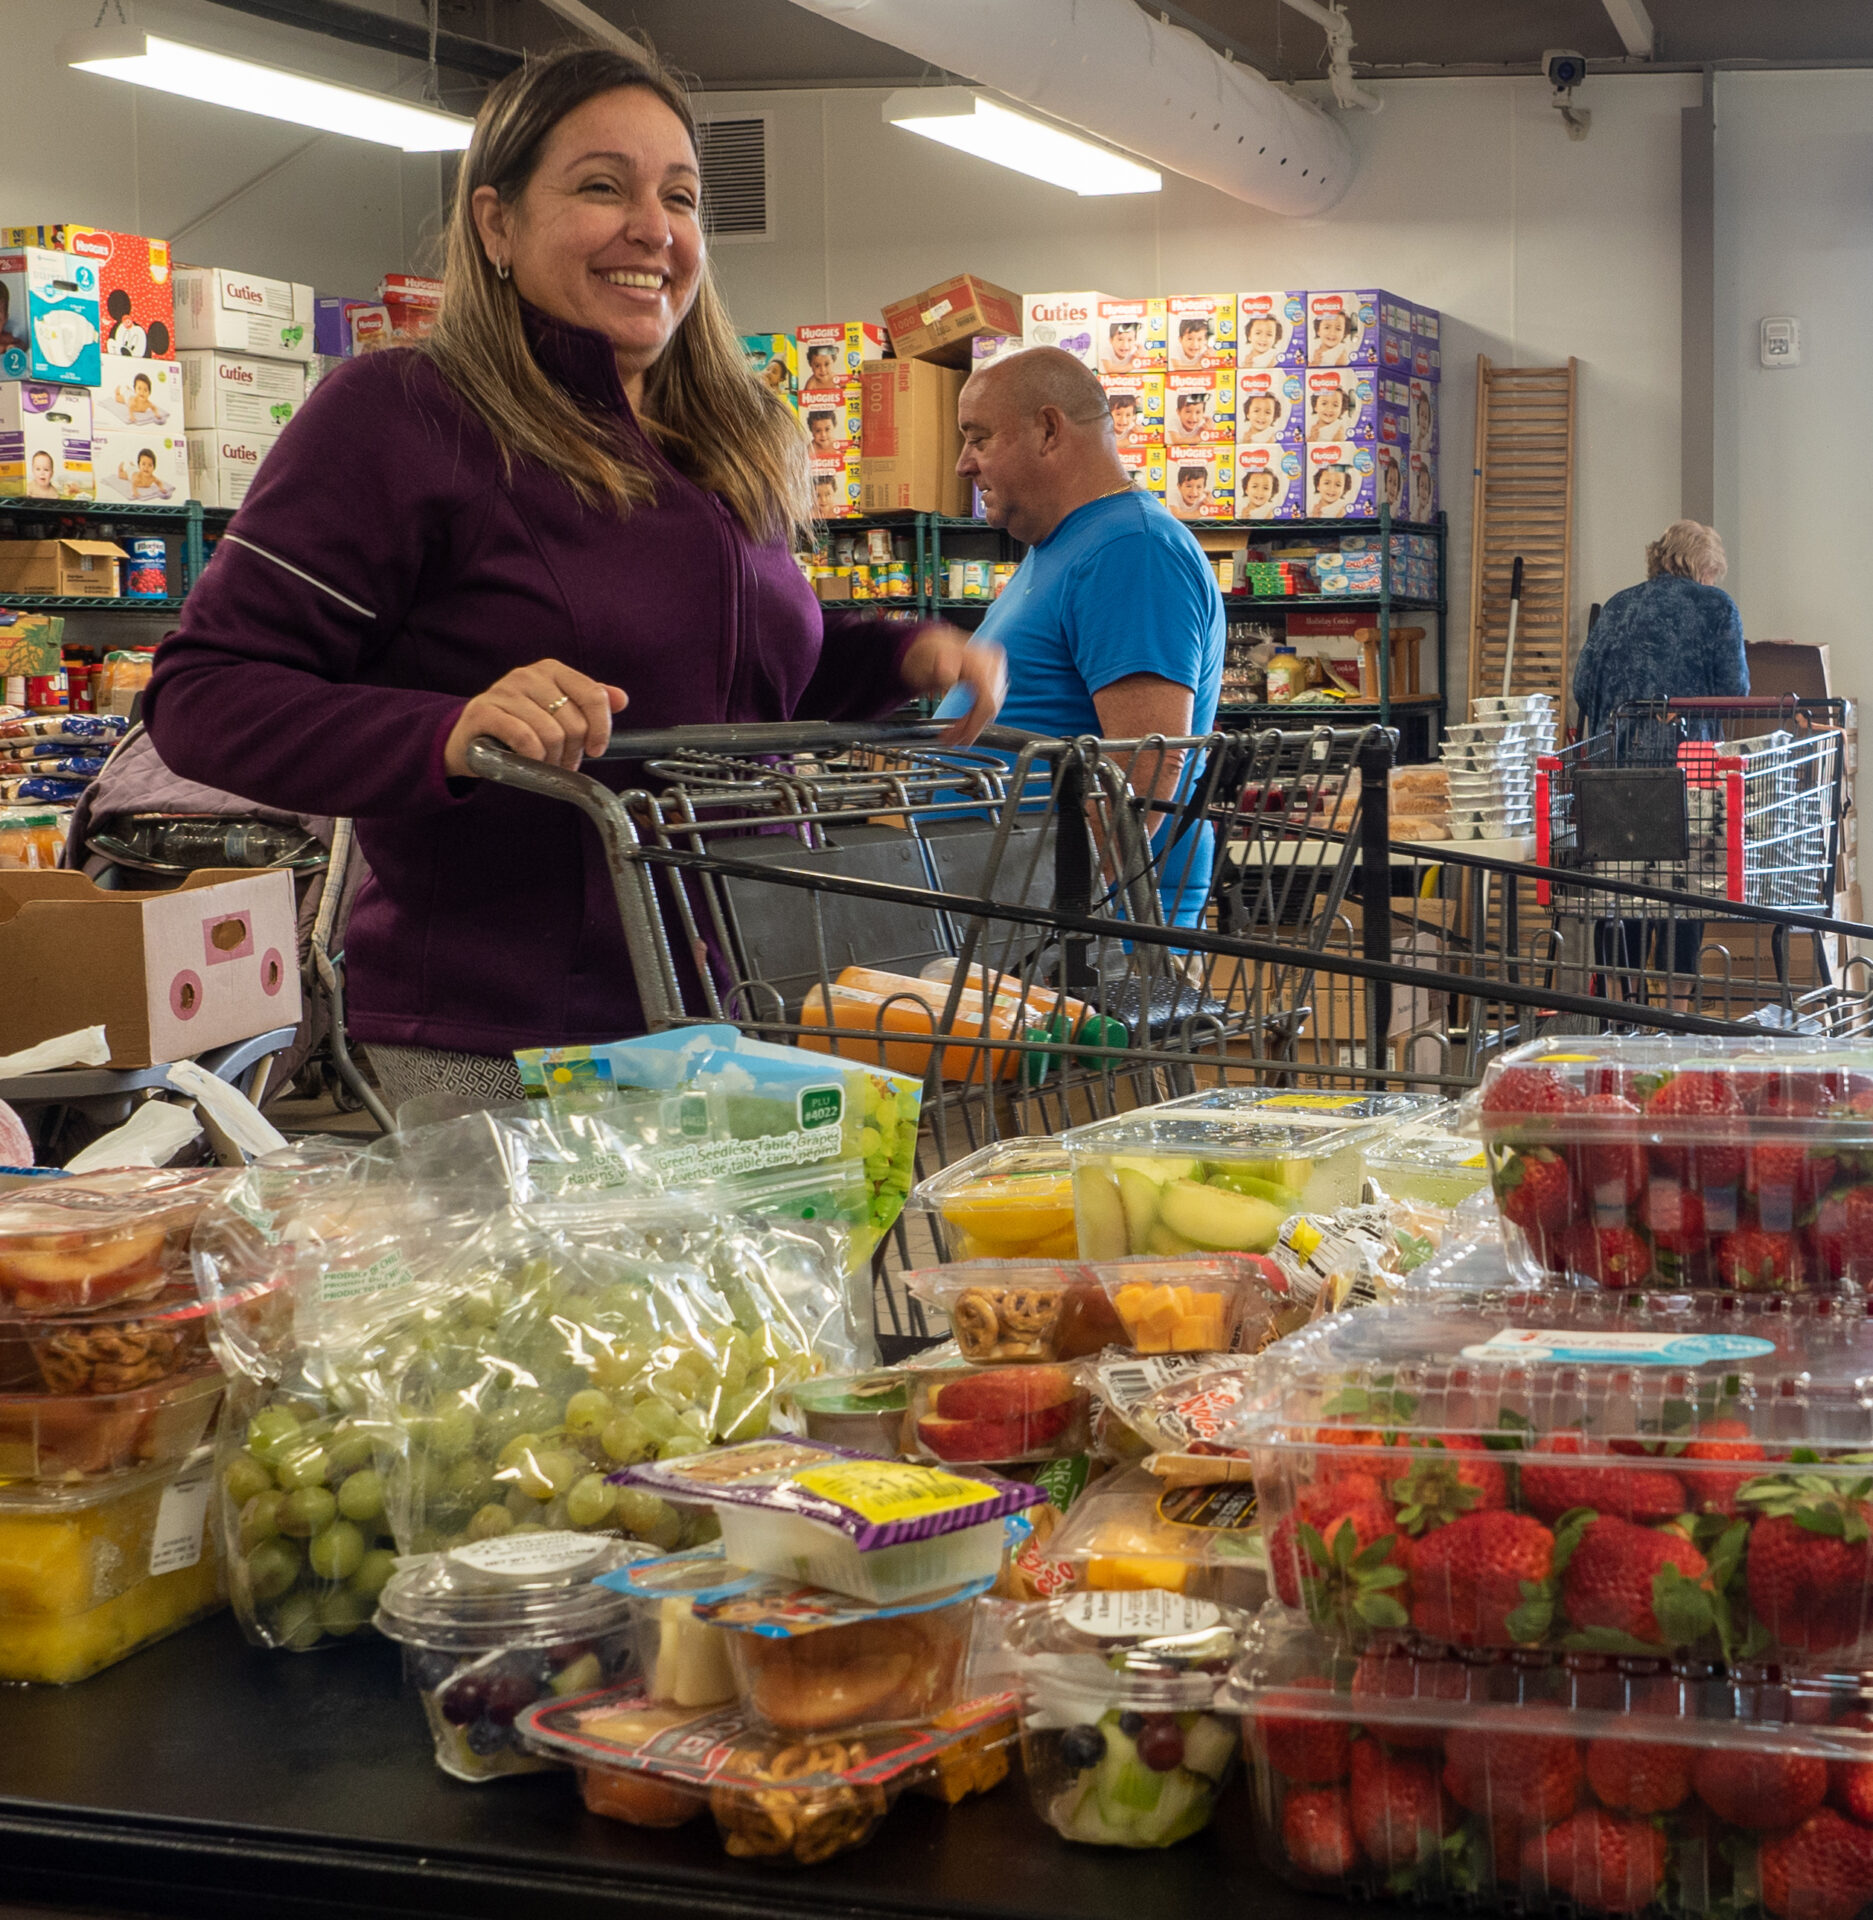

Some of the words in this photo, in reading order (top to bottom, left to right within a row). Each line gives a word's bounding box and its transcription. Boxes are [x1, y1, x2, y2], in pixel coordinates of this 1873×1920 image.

[226, 283, 263, 303] Cuties
[1031, 302, 1088, 322] Cuties
[801, 327, 840, 339] HUGGIES
[219, 364, 253, 383] Cuties
[898, 363, 910, 393] Black
[1170, 375, 1212, 387] HUGGIES
[801, 392, 841, 404] HUGGIES
[870, 374, 882, 412] 1000
[222, 443, 258, 462] Cuties
[1171, 447, 1213, 459] HUGGIES
[810, 457, 840, 468] UGGIES
[1332, 616, 1357, 625] Cookie
[811, 1096, 831, 1107] PLU
[804, 1107, 838, 1122] #4022
[658, 1155, 694, 1171] Green
[698, 1141, 751, 1162] Seedless
[758, 1138, 792, 1153] Table
[797, 1132, 840, 1149] Grapes
[681, 1169, 708, 1182] verts
[711, 1162, 726, 1176] de
[730, 1157, 762, 1173] table
[766, 1153, 794, 1165] sans
